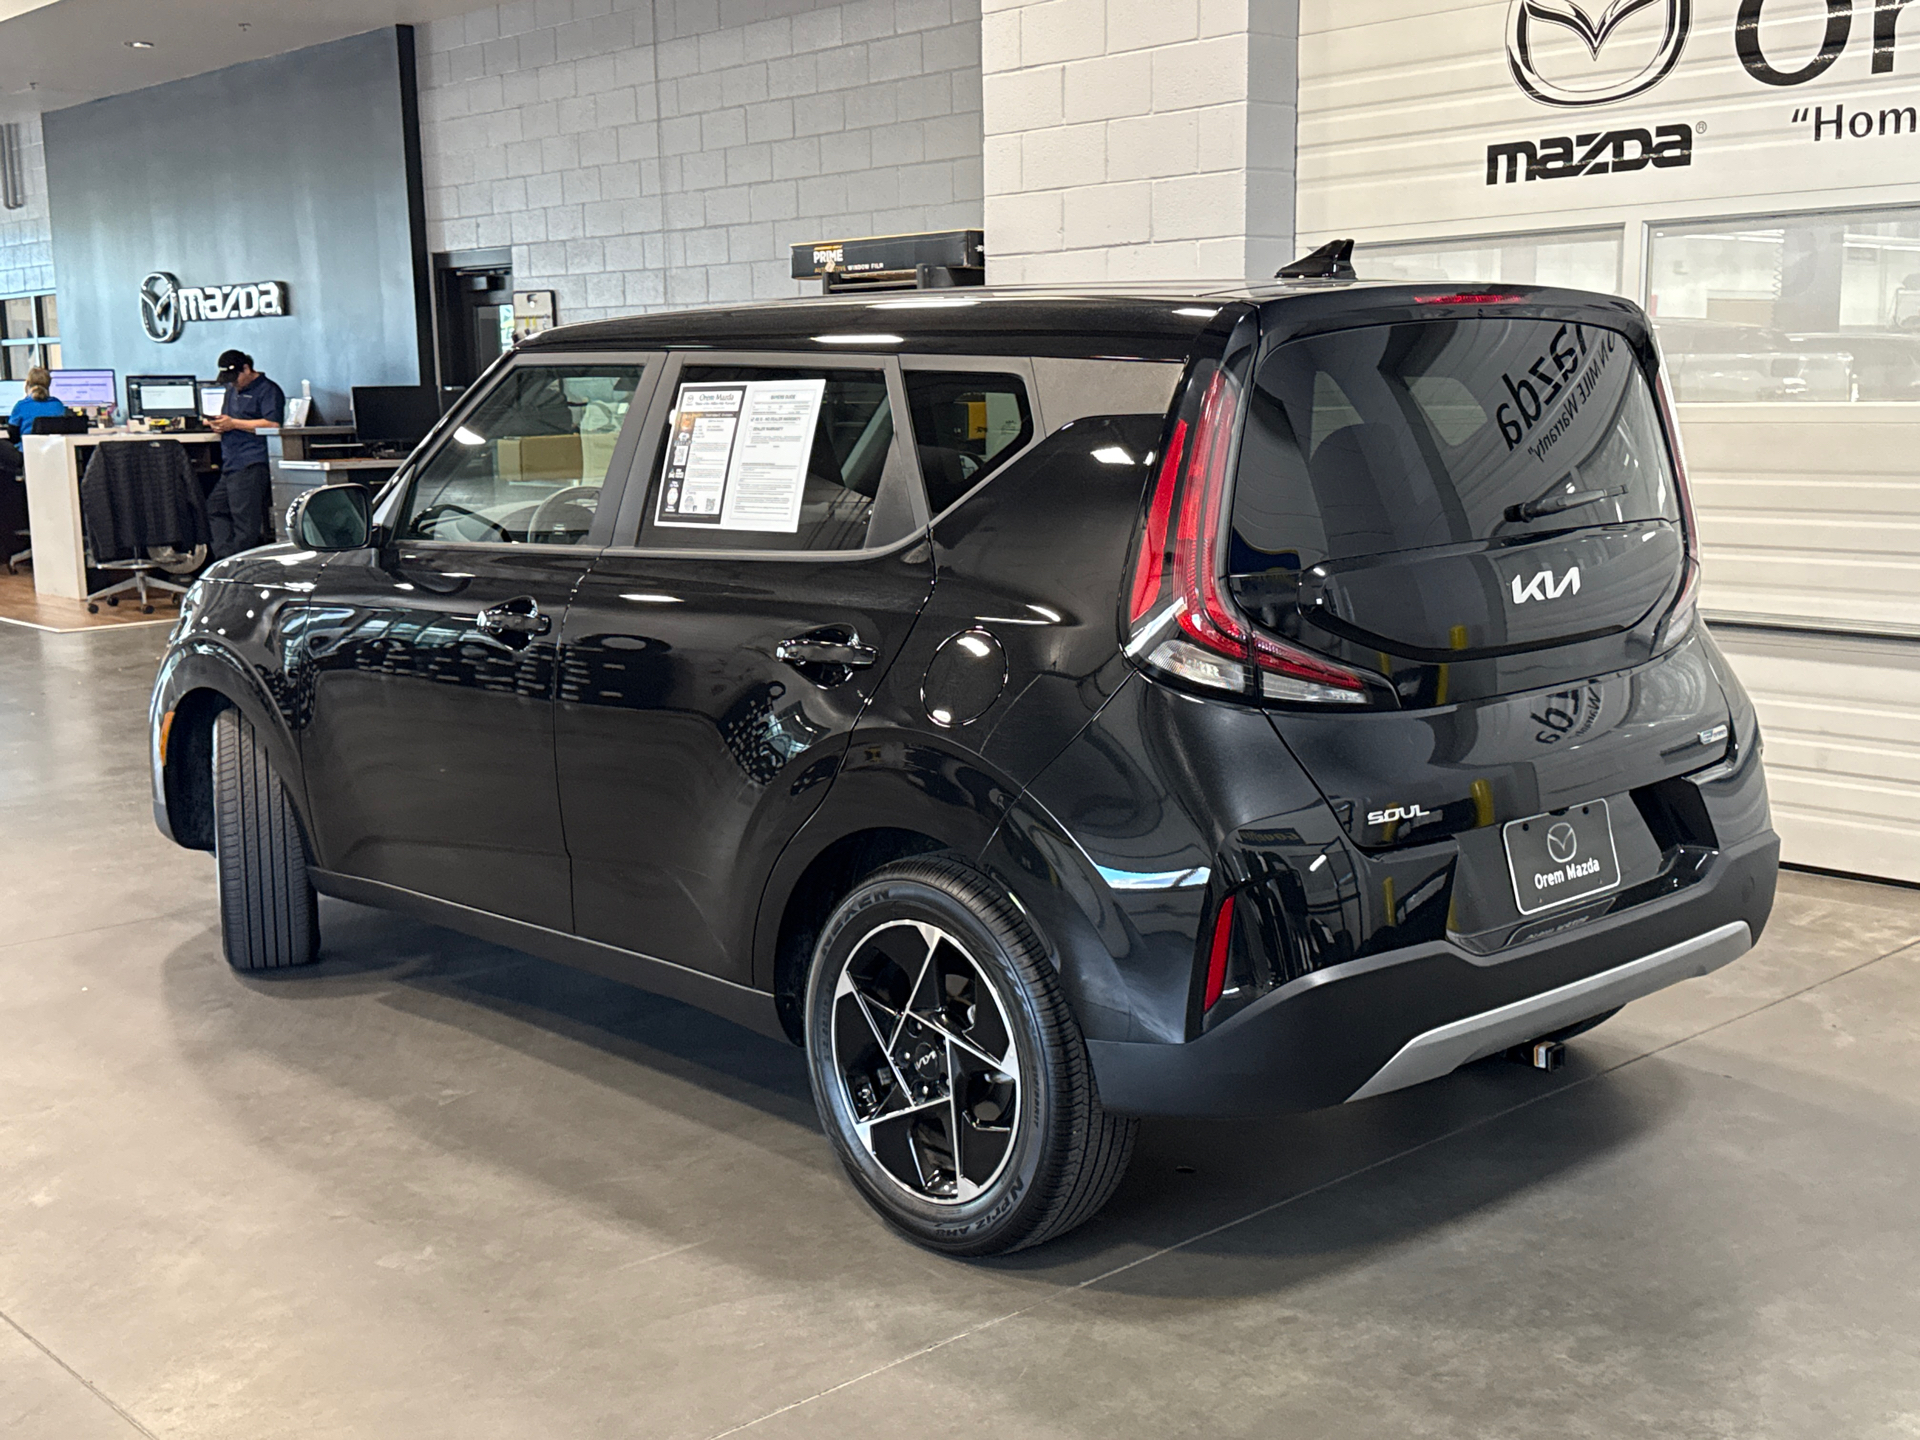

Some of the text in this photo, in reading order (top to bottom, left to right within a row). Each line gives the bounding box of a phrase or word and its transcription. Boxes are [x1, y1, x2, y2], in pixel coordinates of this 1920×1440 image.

[813, 249, 843, 263] PRIME
[1511, 566, 1581, 604] KIA
[1367, 804, 1430, 825] SOUL
[1534, 857, 1601, 890] Orem Mazda
